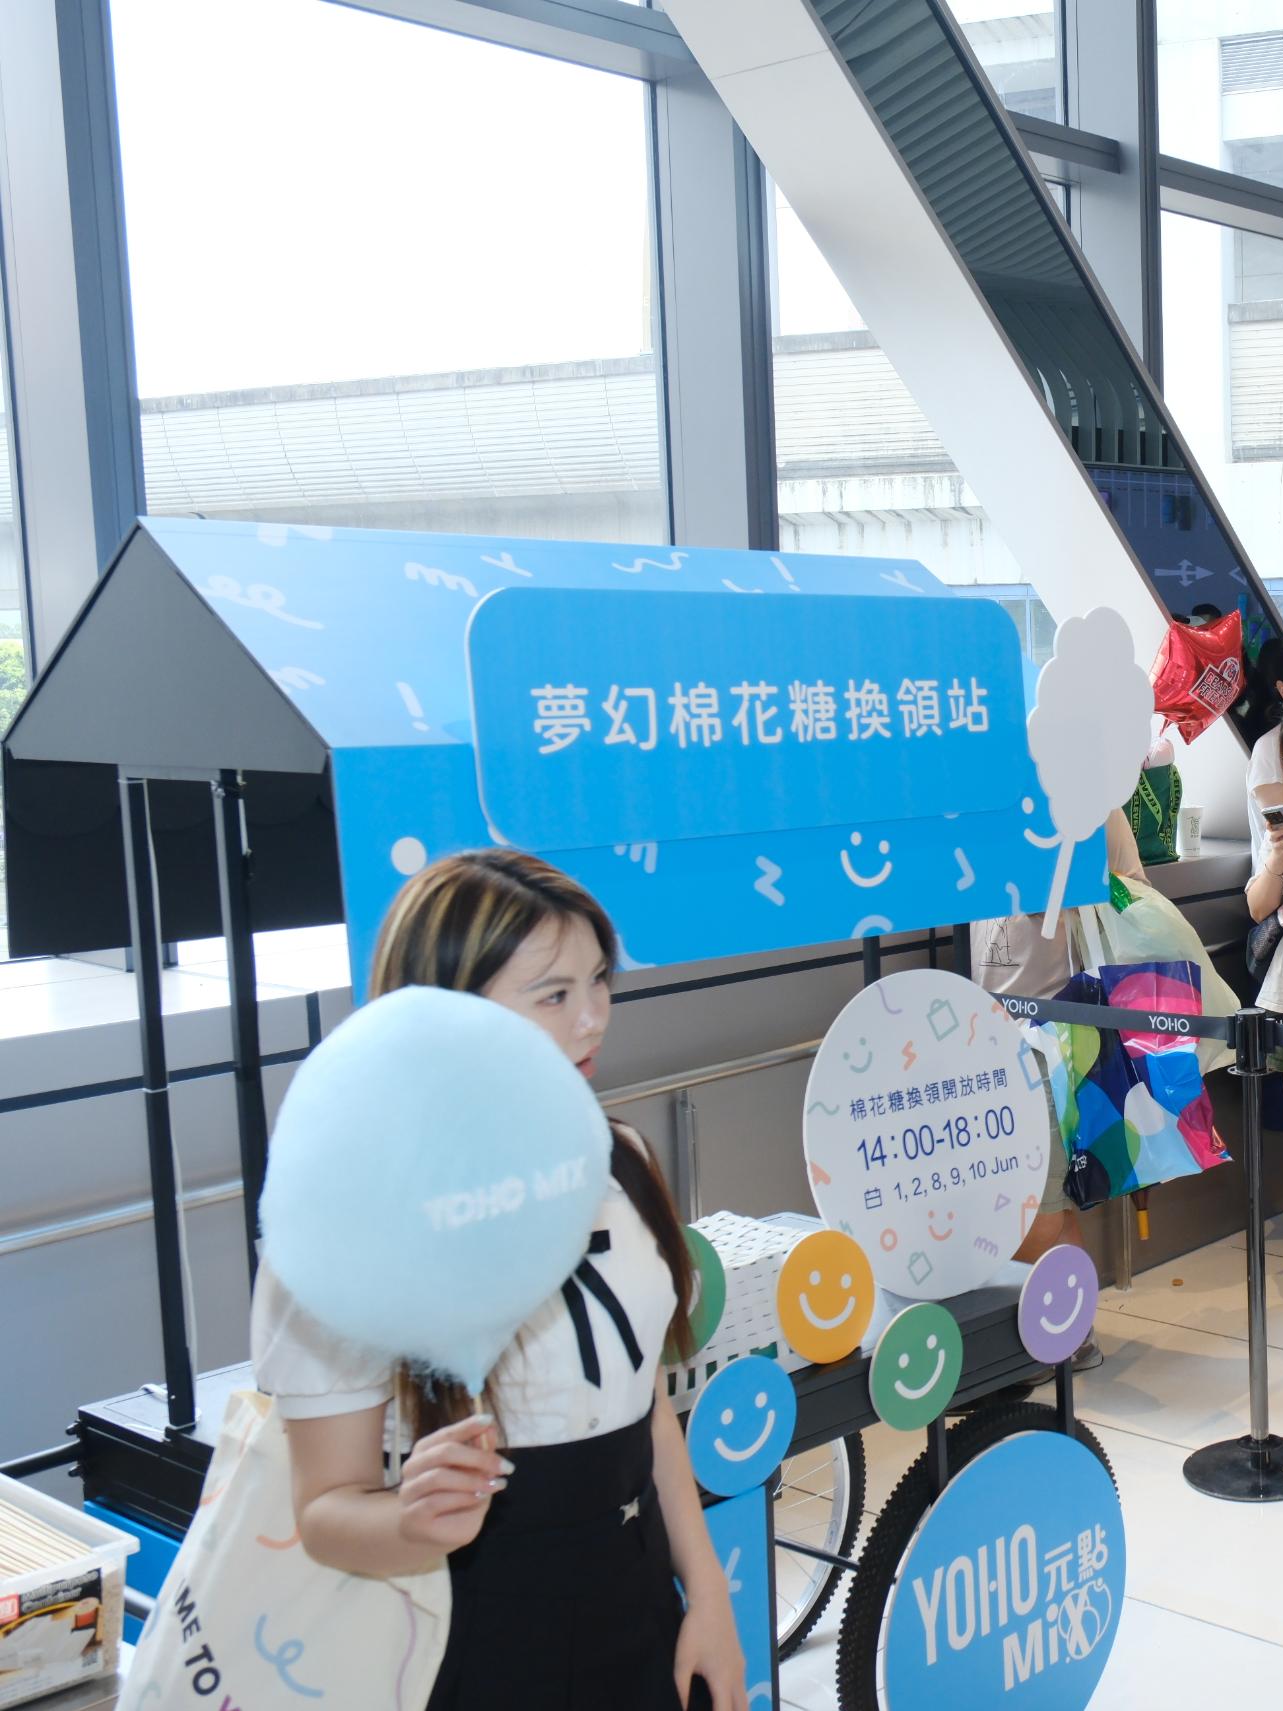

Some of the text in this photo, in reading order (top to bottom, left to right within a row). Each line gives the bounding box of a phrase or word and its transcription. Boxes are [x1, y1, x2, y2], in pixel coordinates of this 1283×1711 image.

[531, 677, 988, 754] 夢幻棉花糖換領站
[1001, 998, 1038, 1016] YOHO
[1149, 1015, 1190, 1033] YOHO
[850, 1068, 1008, 1122] 棉花糖換領開放時間
[857, 1105, 1015, 1171] 14:00-18:00
[969, 1160, 987, 1181] 10
[991, 1155, 1019, 1175] Jun
[424, 1176, 526, 1232] YOHO
[912, 1524, 1038, 1666] YOHO
[174, 1580, 221, 1697] ME TO
